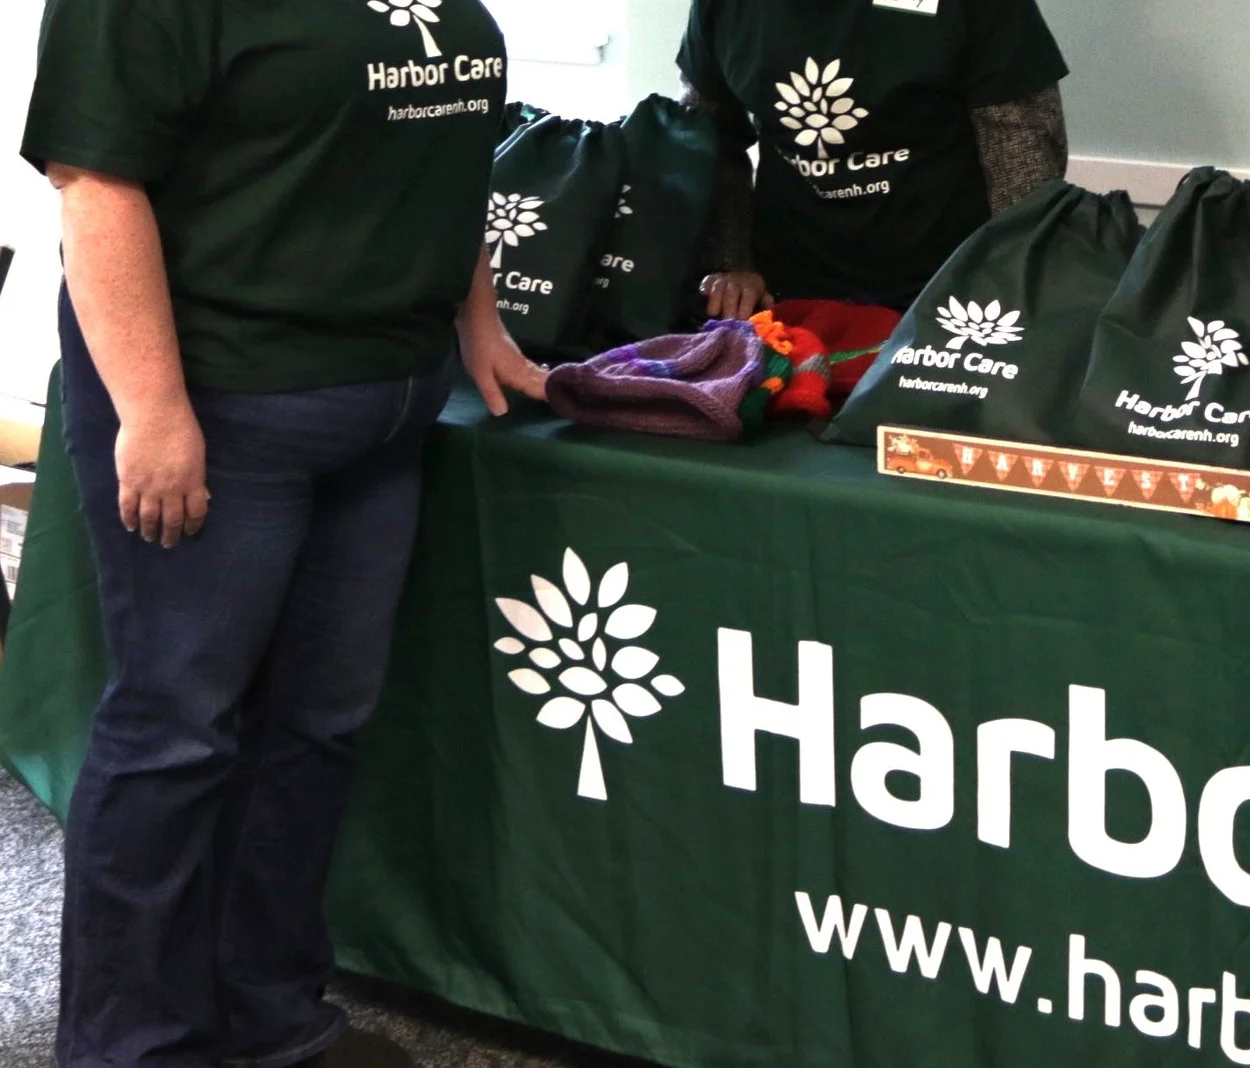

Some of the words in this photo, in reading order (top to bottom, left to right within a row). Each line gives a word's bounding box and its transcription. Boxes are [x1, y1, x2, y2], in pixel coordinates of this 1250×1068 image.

[367, 60, 448, 91] Harbor
[454, 55, 502, 82] Care
[387, 98, 489, 121] harborcarenh.org
[790, 154, 840, 177] bor
[846, 148, 910, 171] Care
[819, 180, 890, 199] carenh.org
[602, 254, 635, 272] are
[505, 271, 553, 294] Care
[963, 352, 1019, 380] Care
[899, 375, 989, 399] harborcarenh.org
[1115, 390, 1201, 422] Harbor
[1127, 421, 1240, 447] harborcarenh.org
[962, 446, 1189, 492] HARVEST
